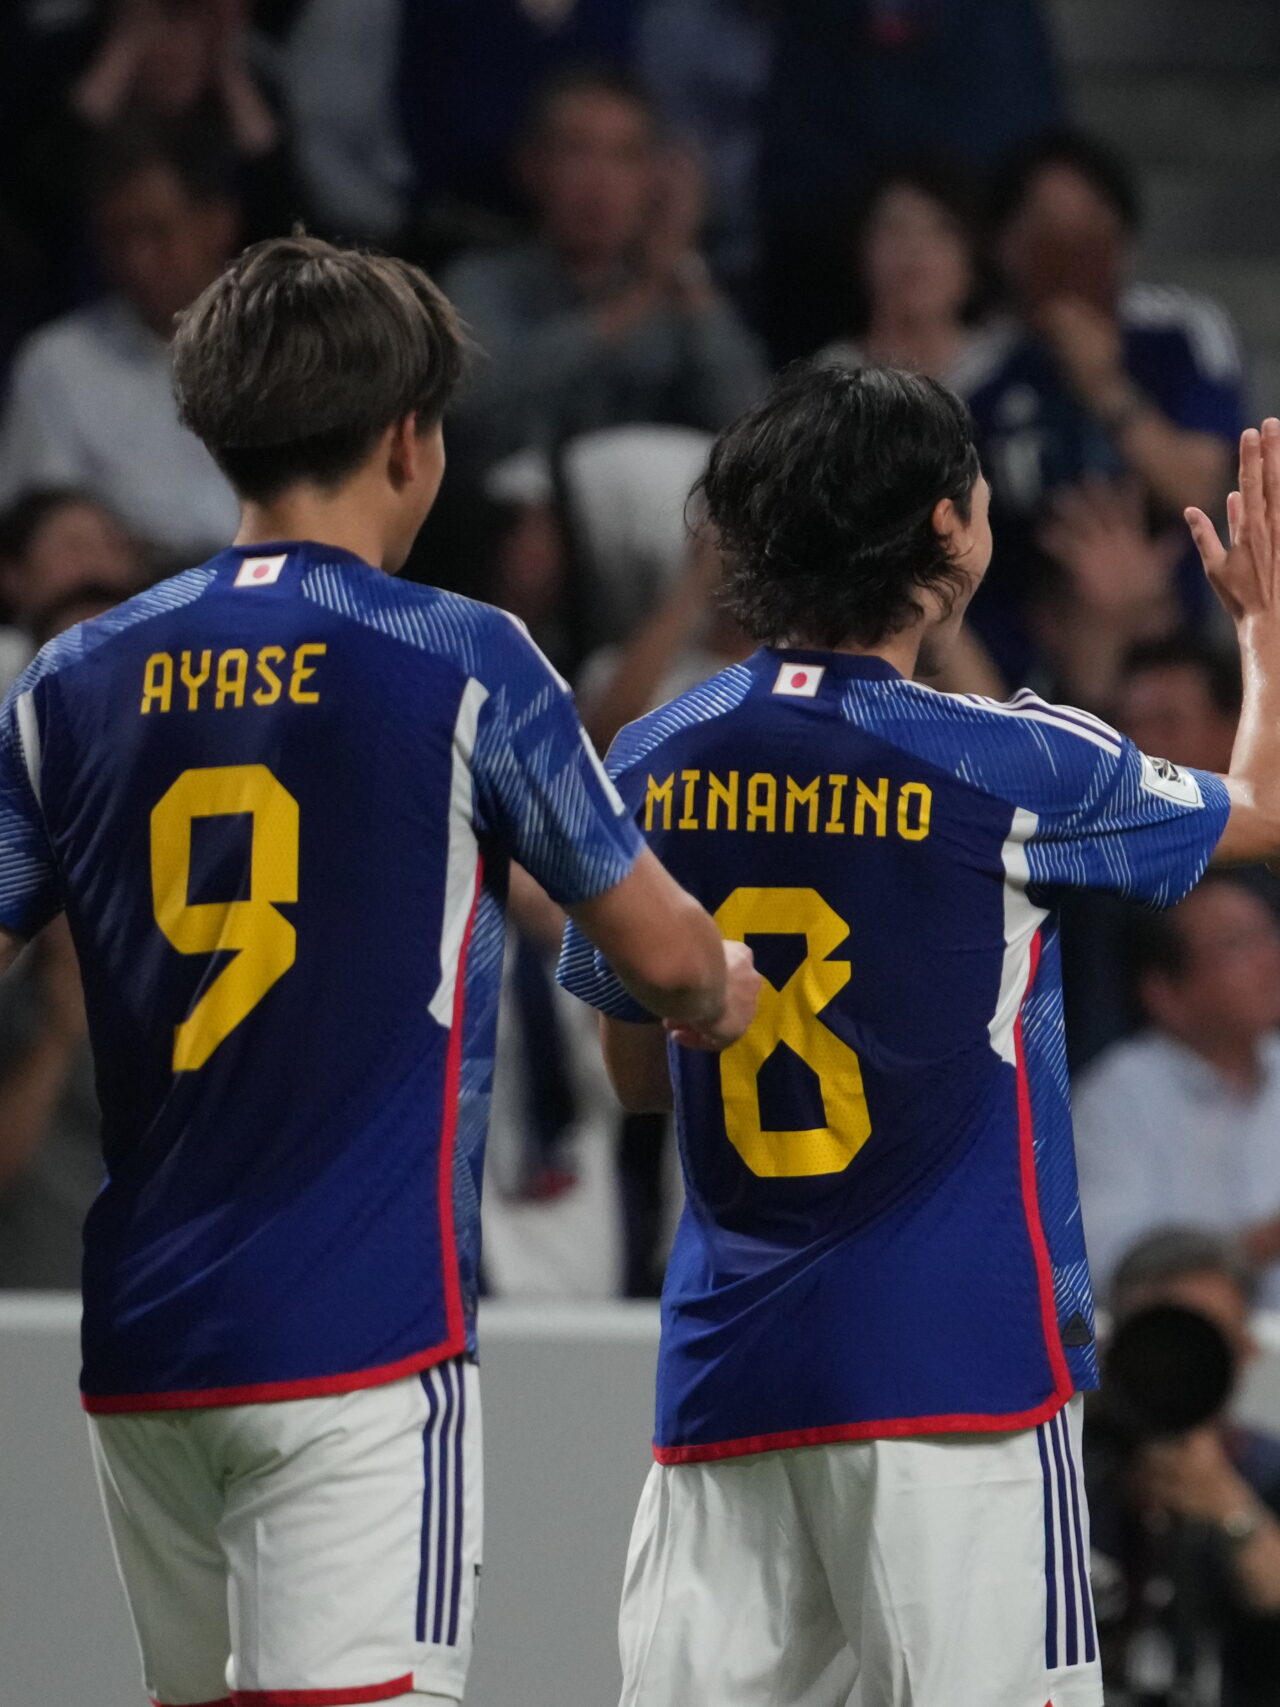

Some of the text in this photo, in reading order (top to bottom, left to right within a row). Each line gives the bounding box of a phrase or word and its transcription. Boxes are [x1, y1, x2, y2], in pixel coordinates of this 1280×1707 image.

[141, 643, 328, 715] AYASE
[645, 769, 933, 842] MINAMINO
[150, 763, 300, 1072] 9
[711, 886, 872, 1178] 8
